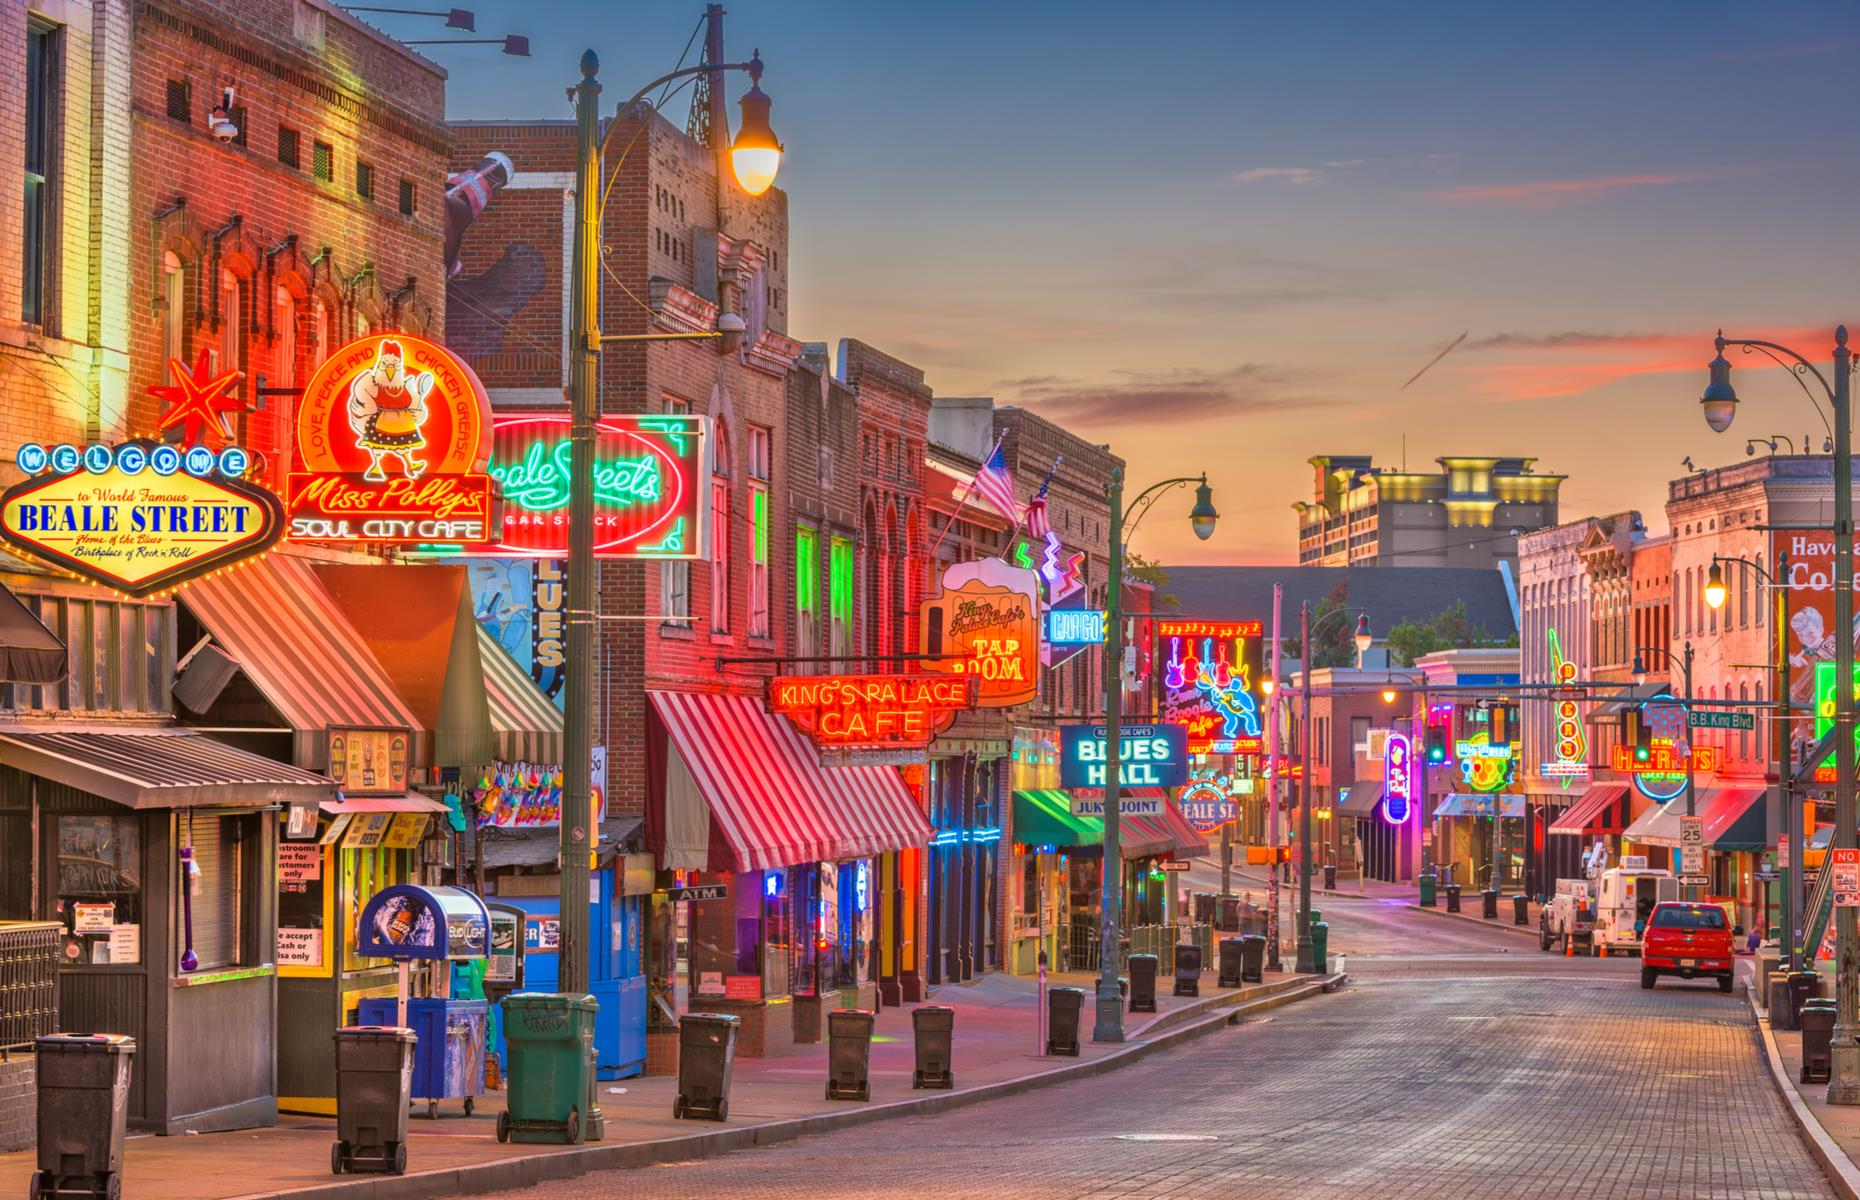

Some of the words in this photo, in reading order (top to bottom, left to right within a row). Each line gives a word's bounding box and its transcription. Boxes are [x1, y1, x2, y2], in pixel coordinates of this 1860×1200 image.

[315, 363, 348, 410] PEACE
[346, 346, 375, 369] AND
[414, 349, 464, 399] CHICKEN
[452, 400, 472, 463] GREASE
[20, 446, 246, 475] WELCOME
[490, 442, 560, 489] eale
[77, 492, 90, 502] to
[93, 488, 135, 502] World
[139, 488, 189, 503] Famous
[291, 476, 375, 509] Miss
[18, 504, 119, 532] BEALE
[131, 505, 250, 533] STREET
[291, 518, 358, 539] SOUL
[418, 519, 483, 539] CAFE
[76, 534, 106, 546] Home
[109, 534, 118, 546] of
[119, 534, 135, 544] the
[137, 534, 165, 544] Blues
[71, 546, 122, 561] Birthplace
[125, 549, 135, 561] of
[136, 546, 160, 558] Rock
[168, 547, 197, 558] Roll
[536, 560, 564, 667] LUES
[1052, 613, 1100, 642] CARGO
[972, 639, 1020, 659] TAP
[781, 681, 856, 705] KING'S
[821, 710, 924, 737] CAFE
[1690, 713, 1710, 726] B.B.
[1711, 713, 1730, 728] King
[1732, 714, 1753, 728] Blvd.
[1119, 801, 1158, 813] JOINT
[1683, 830, 1701, 841] 25
[1837, 852, 1855, 862] NO
[284, 870, 303, 879] only
[680, 888, 718, 899] ATM
[286, 932, 313, 941] accept
[448, 926, 465, 939] BUD
[466, 926, 486, 939] LIGHT
[291, 951, 310, 961] only
